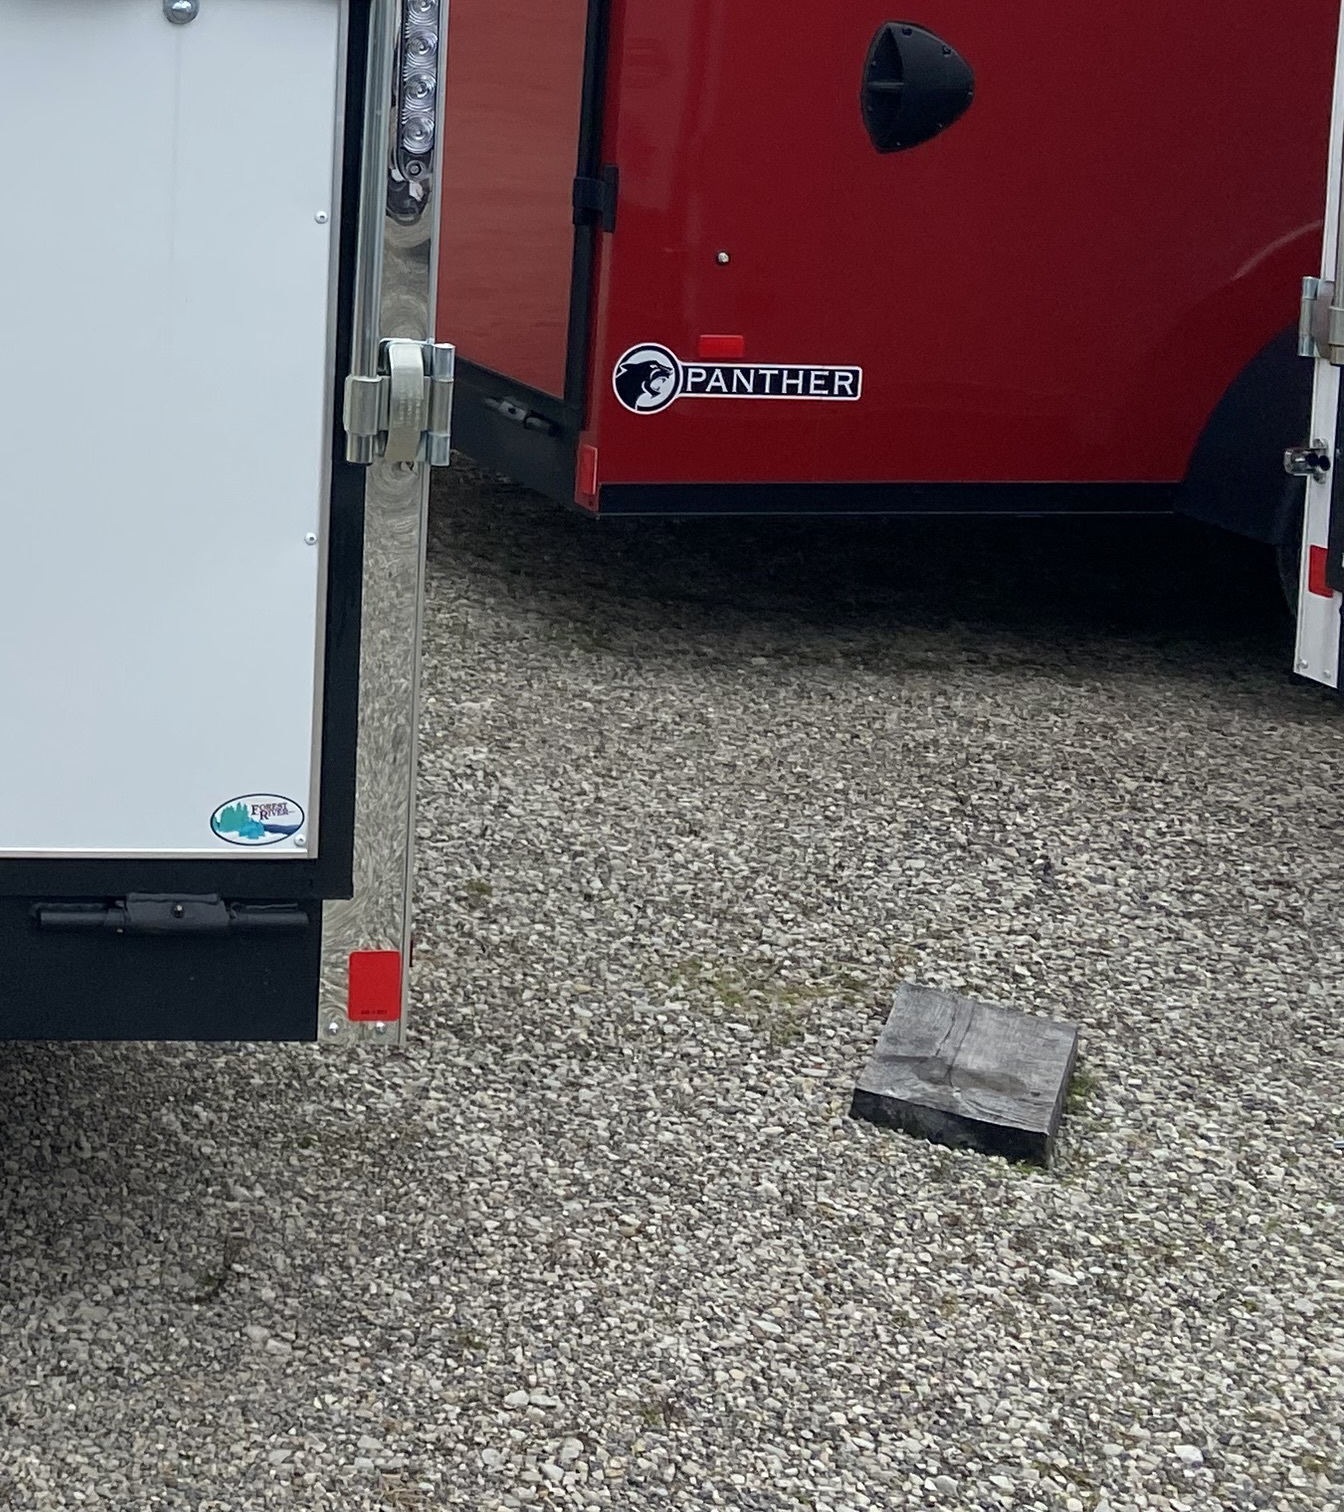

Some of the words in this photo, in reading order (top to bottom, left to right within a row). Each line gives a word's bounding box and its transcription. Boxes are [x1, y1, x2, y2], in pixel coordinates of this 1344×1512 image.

[686, 368, 854, 395] PANTHER
[251, 802, 288, 816] FOREST
[260, 808, 289, 821] RIVER
